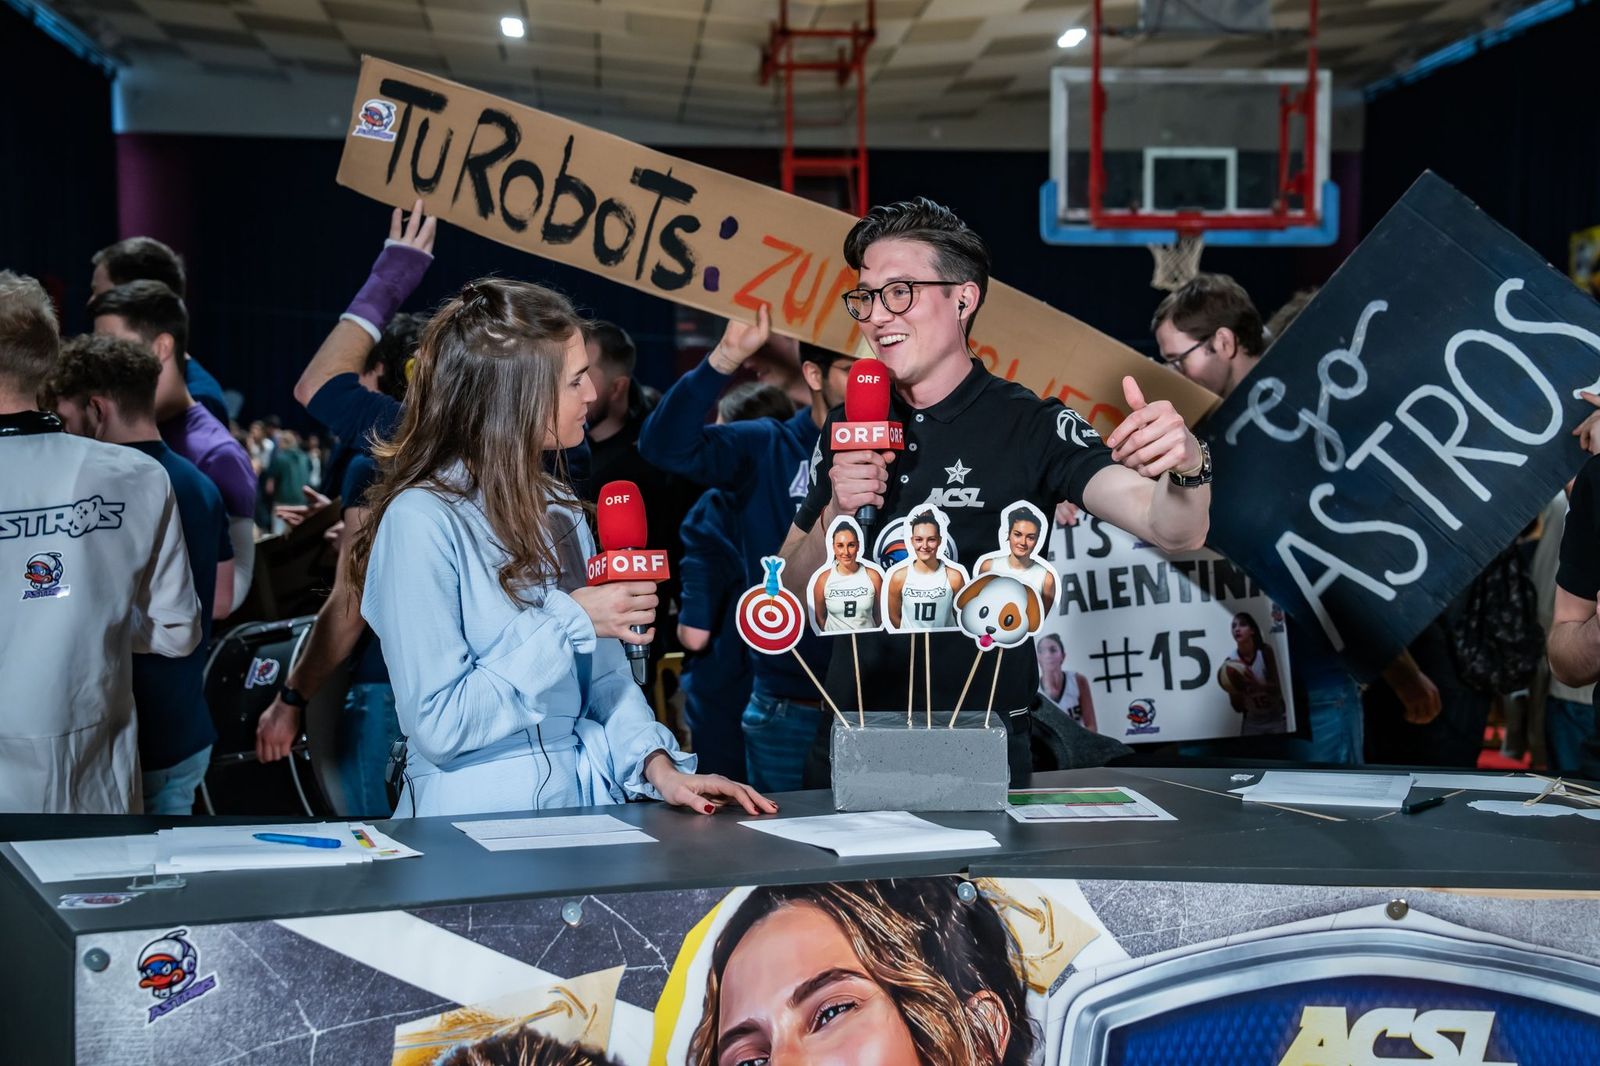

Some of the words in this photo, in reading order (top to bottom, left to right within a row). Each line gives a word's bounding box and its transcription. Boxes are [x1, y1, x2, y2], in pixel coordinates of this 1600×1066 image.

[856, 374, 881, 384] ORF
[835, 426, 886, 444] ORF
[889, 427, 903, 444] ORF
[1274, 277, 1600, 653] ASTROS
[605, 494, 631, 506] ORF
[922, 487, 985, 508] ACSL
[588, 556, 608, 580] ORF
[611, 554, 665, 573] ORF
[829, 587, 869, 598] ASTROS
[904, 586, 947, 599] ASTROS
[1059, 558, 1262, 617] ALENTIN
[843, 600, 857, 618] 8
[914, 602, 937, 621] 10
[1088, 629, 1212, 694] #15
